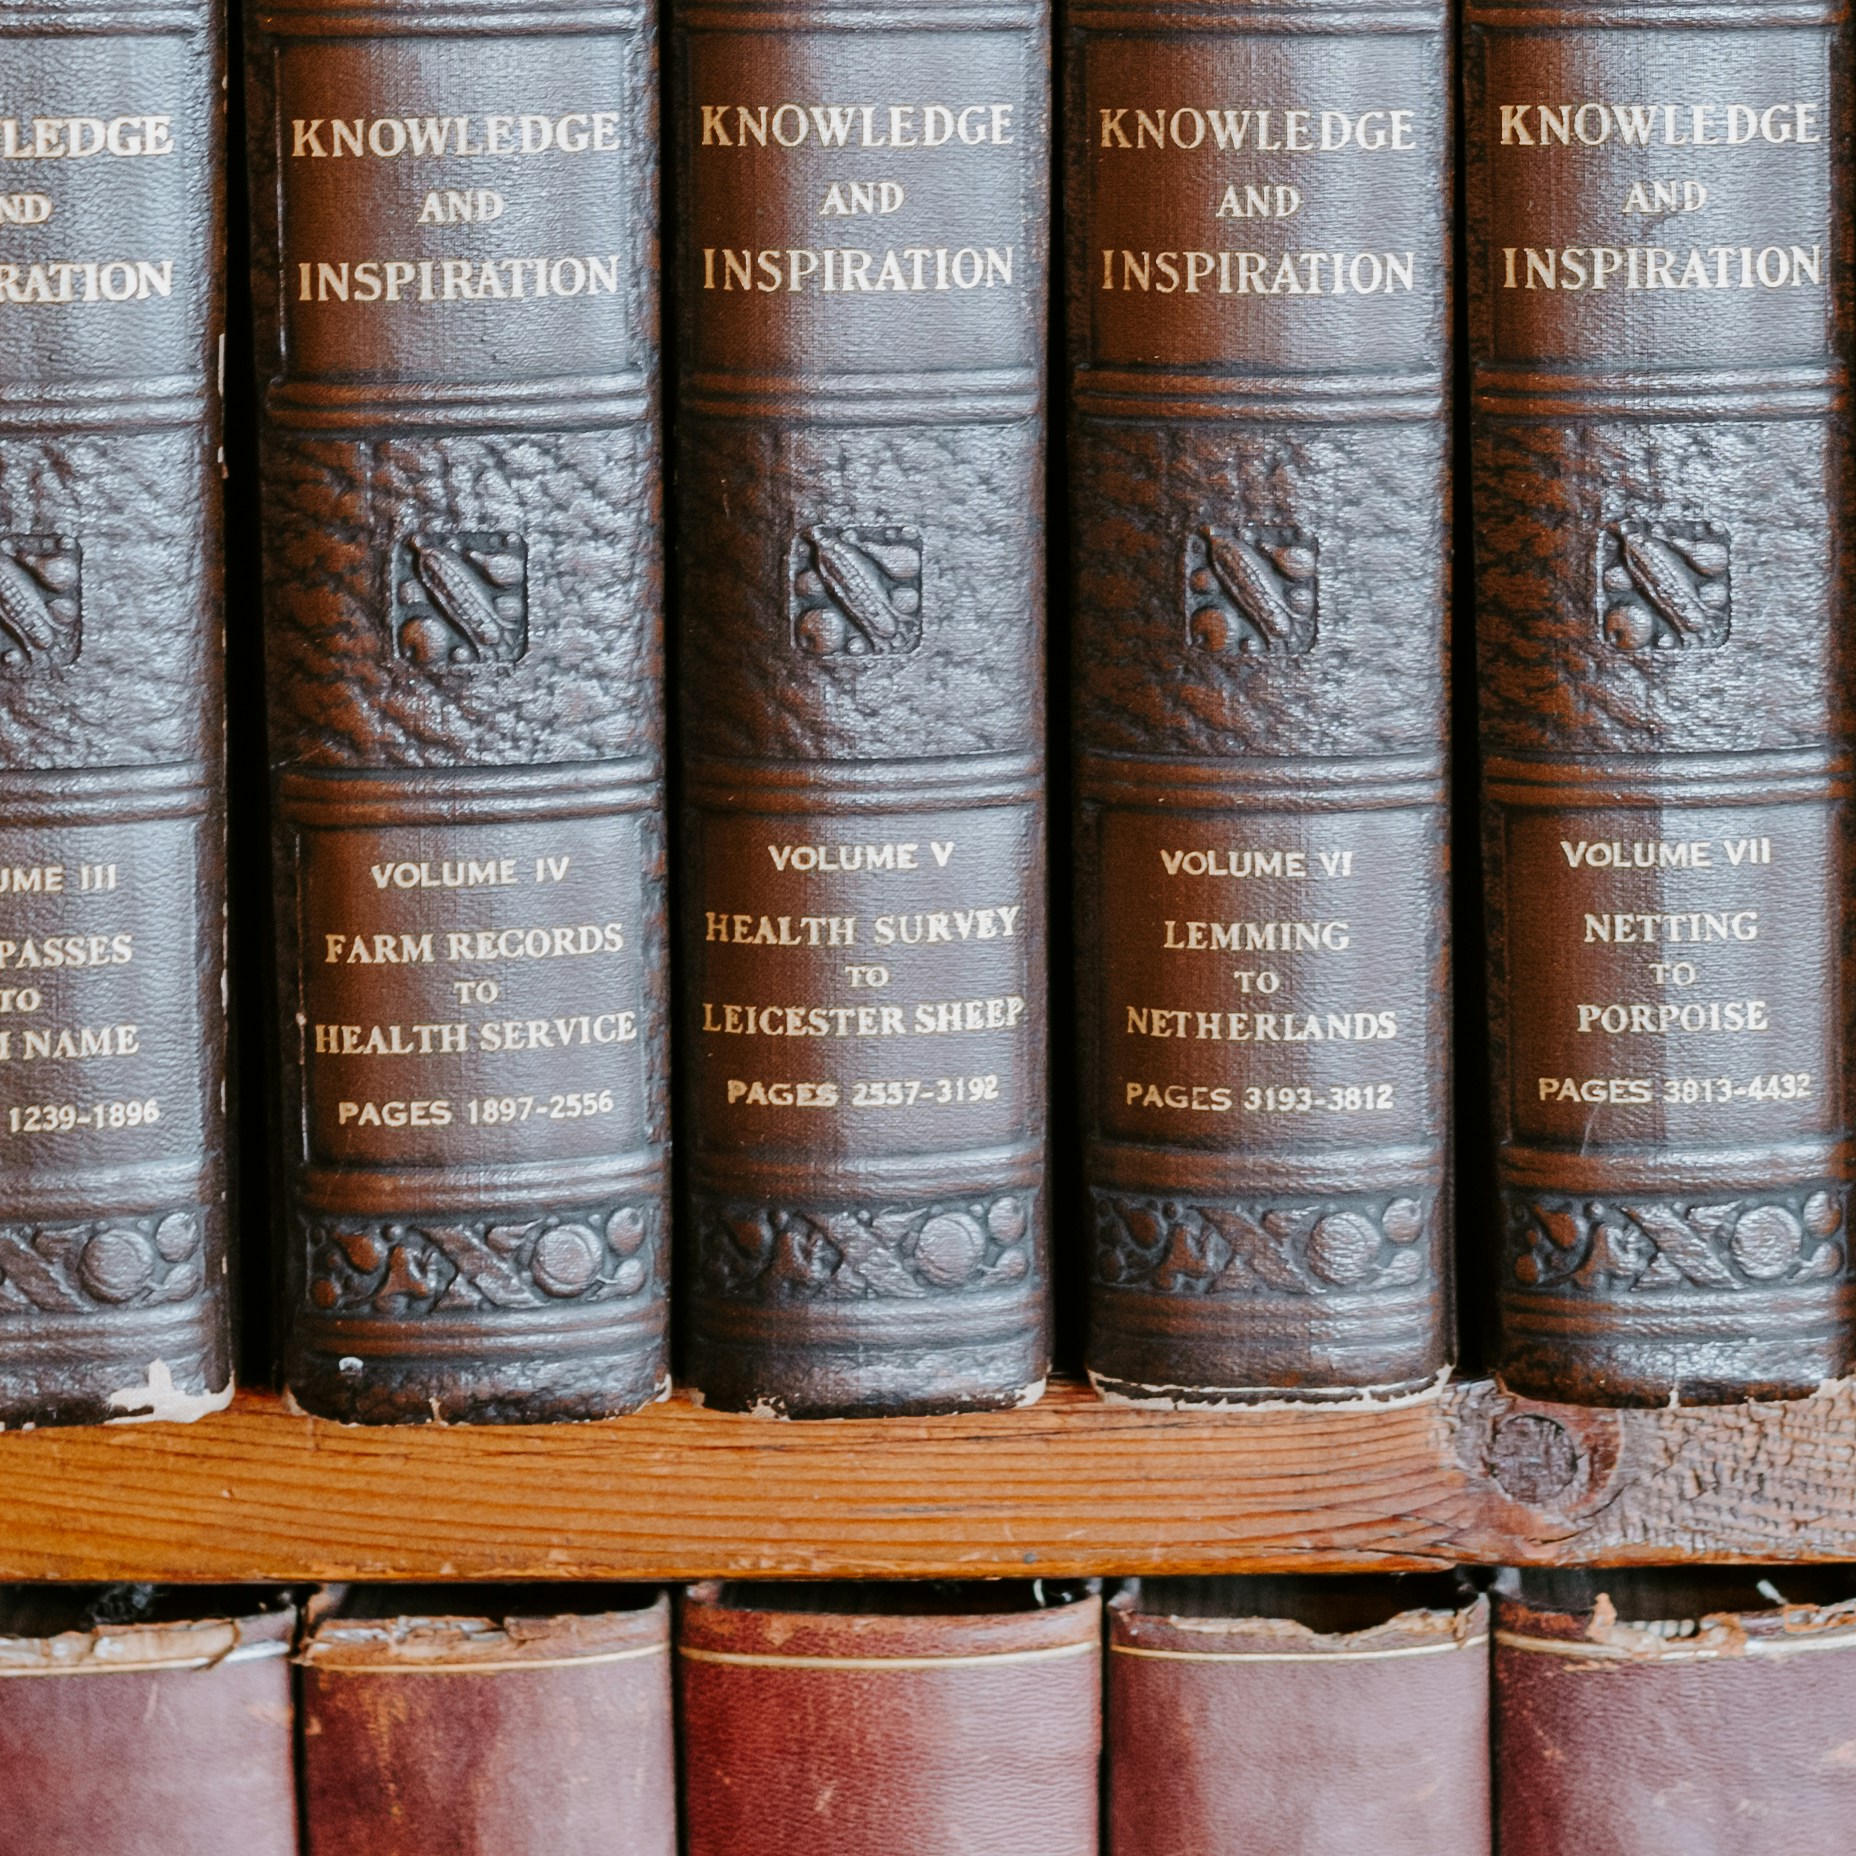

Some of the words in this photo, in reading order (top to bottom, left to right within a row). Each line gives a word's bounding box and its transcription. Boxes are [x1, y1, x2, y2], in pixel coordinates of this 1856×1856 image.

[291, 112, 620, 158] KNOWLEDGE
[700, 104, 1014, 147] KNOWLEDGE
[1100, 108, 1416, 151] KNOWLEDGE
[1499, 104, 1820, 146] KNOWLEDGE
[299, 255, 620, 301] INSPIRATION
[702, 247, 1014, 292] INSPIRATION
[1102, 250, 1415, 294] INSPIRATION
[1502, 245, 1822, 290] INSPIRATION
[768, 844, 919, 872] VOLUME
[934, 842, 955, 868] V
[1161, 850, 1306, 878] VOLUME
[1319, 850, 1354, 876] VI
[1560, 841, 1712, 869] VOLUME
[1723, 839, 1771, 865] VII
[80, 864, 116, 890] III
[371, 859, 518, 888] VOLUME
[535, 857, 570, 884] IV
[704, 912, 857, 946] HEALTH
[874, 906, 1022, 944] SURVEY
[1163, 920, 1351, 951] LEMMING
[1584, 912, 1758, 944] NETTING
[325, 934, 434, 964] FARM
[448, 924, 624, 960] RECORDS
[315, 1026, 467, 1056] HEALTH
[479, 1011, 637, 1052] SERVICE
[702, 1005, 904, 1036] LEICESTER
[914, 996, 1025, 1032] SHEEP
[1125, 1007, 1397, 1042] NETHERLANDS
[1577, 1001, 1769, 1034] PORPOISE
[23, 1025, 139, 1058] NAME
[728, 1080, 838, 1107] PAGES
[852, 1074, 999, 1107] 2557-3192
[1126, 1083, 1233, 1111] PAGES
[1243, 1084, 1394, 1111] 3193-3812
[1538, 1078, 1652, 1103] PAGES
[1664, 1072, 1811, 1103] 3813-4432
[9, 1100, 160, 1132] 1239-1896
[338, 1101, 452, 1127] PAGES
[467, 1090, 615, 1123] 1897-2556
